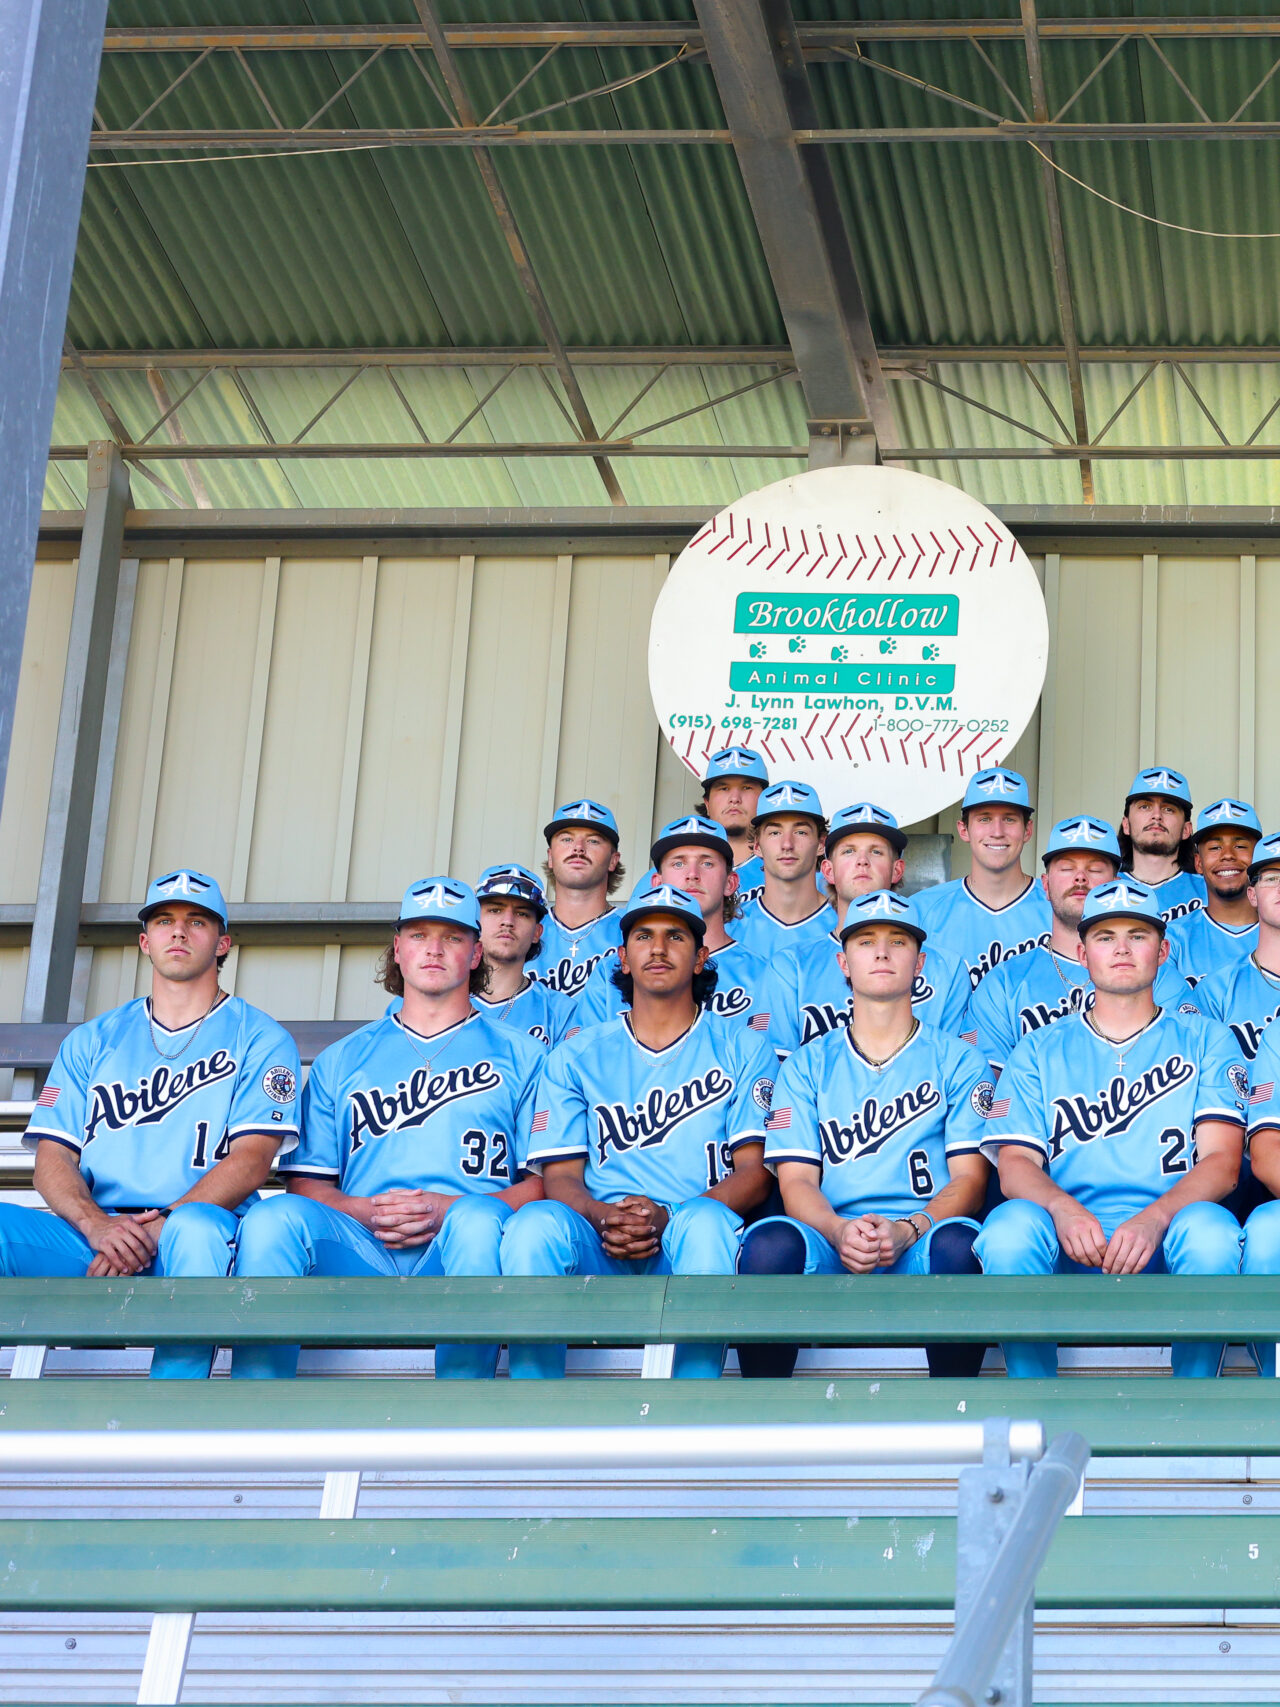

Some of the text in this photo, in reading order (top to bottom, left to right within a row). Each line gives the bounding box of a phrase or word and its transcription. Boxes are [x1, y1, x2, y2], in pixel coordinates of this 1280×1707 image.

[747, 598, 949, 632] Brookhollow
[747, 670, 938, 686] Animal Clinic
[725, 694, 958, 713] J. Lynn Lawhon, D.V.M.
[669, 714, 798, 731] (915) 698-7281
[873, 718, 1009, 733] 1-800-777-0252
[84, 1048, 237, 1149] Abilene
[347, 1060, 501, 1155] Abilene
[1047, 1054, 1197, 1163] Abilene
[593, 1066, 735, 1167] Abilene
[818, 1080, 942, 1167] Abilene
[460, 1128, 509, 1178] 32
[907, 1150, 934, 1196] 6
[640, 1403, 649, 1415] 3
[957, 1401, 966, 1412] 4
[1248, 1544, 1259, 1559] 5
